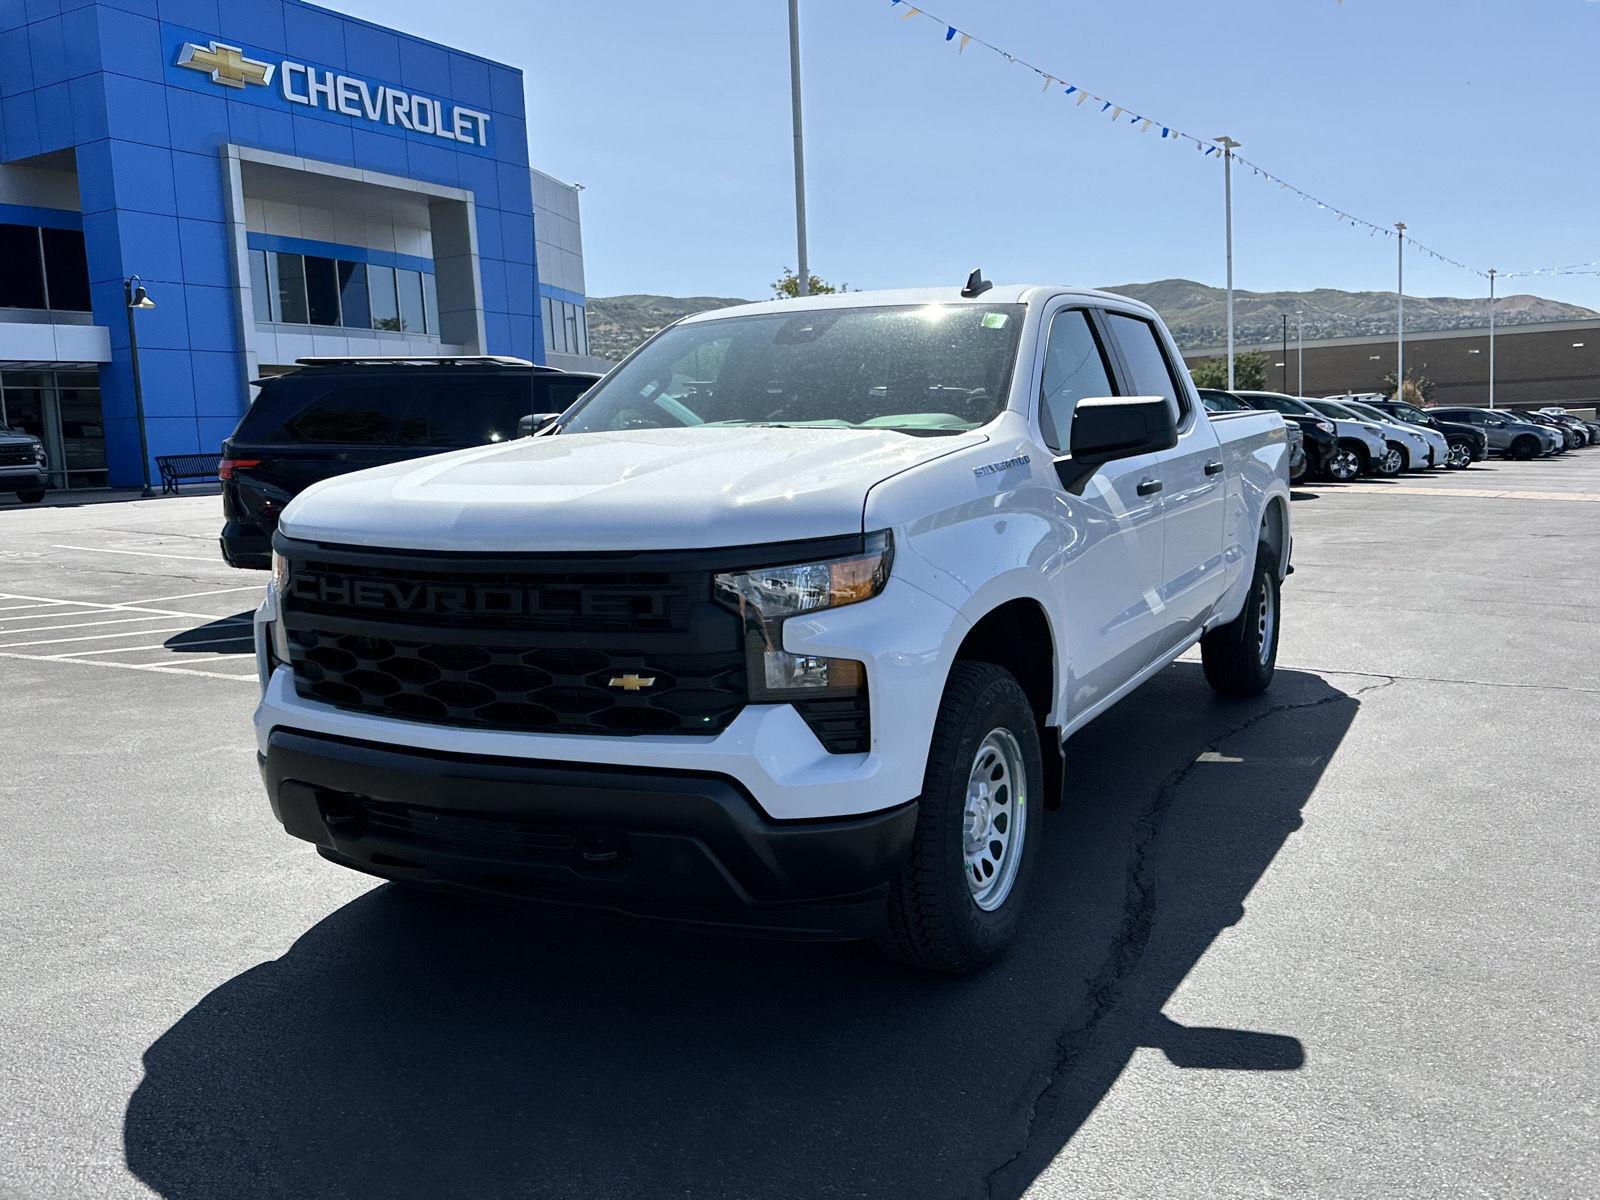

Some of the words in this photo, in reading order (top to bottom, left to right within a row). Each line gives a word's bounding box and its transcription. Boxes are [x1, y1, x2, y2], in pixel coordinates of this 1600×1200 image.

[281, 60, 491, 147] CHEVROLET
[973, 454, 1031, 475] SILVERADO
[289, 574, 669, 616] CHEVROLET
